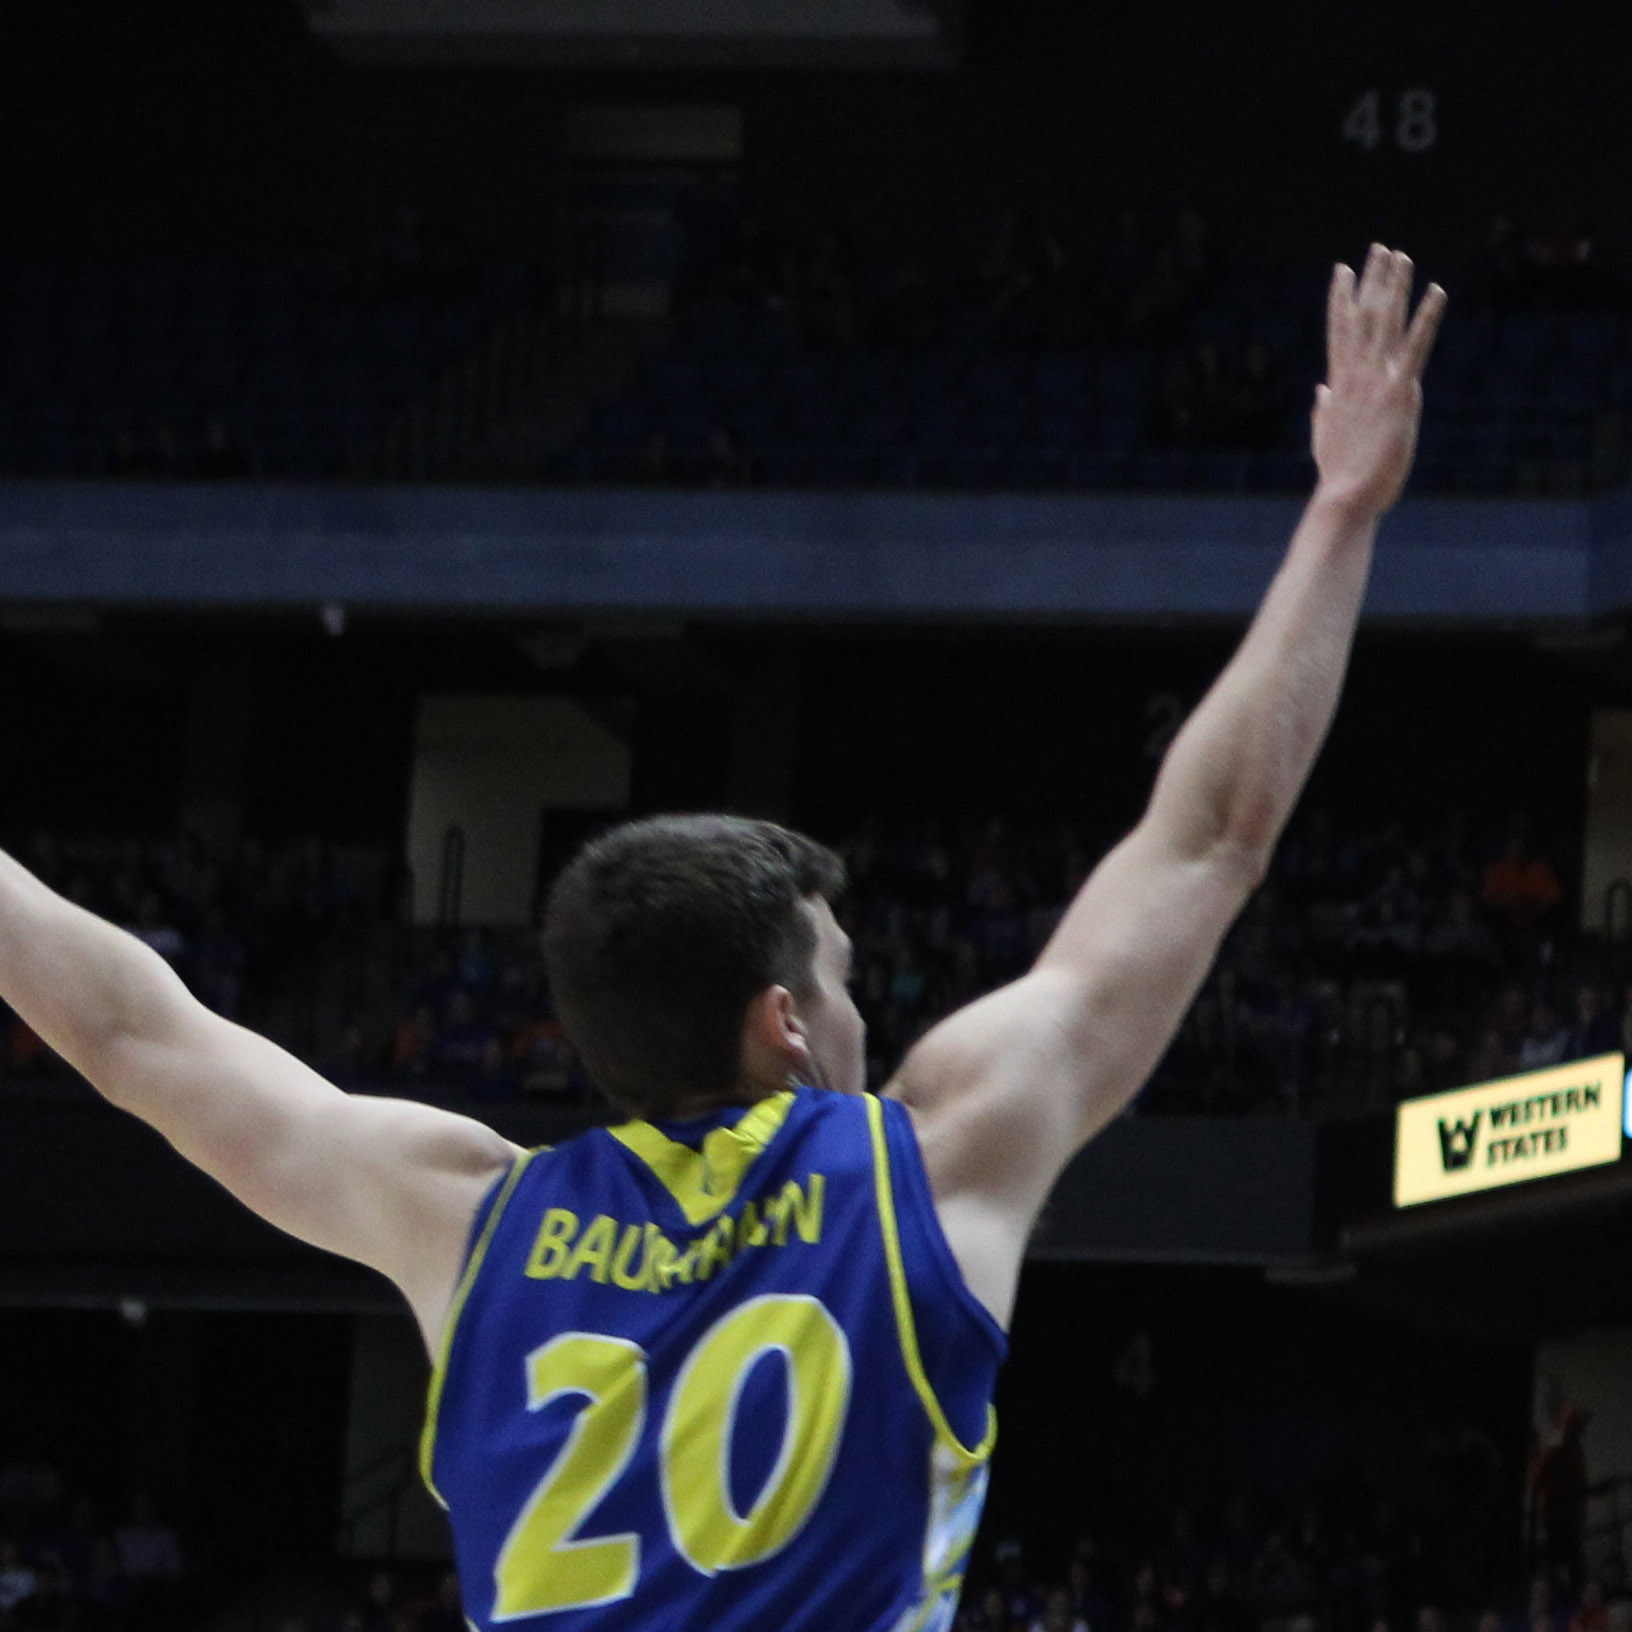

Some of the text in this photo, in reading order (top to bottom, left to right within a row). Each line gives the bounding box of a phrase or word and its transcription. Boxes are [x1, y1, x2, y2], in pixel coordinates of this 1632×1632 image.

[1341, 87, 1439, 153] 48
[1488, 1081, 1602, 1129] WESTERN
[1487, 1126, 1568, 1167] STATES
[490, 1293, 853, 1624] 20
